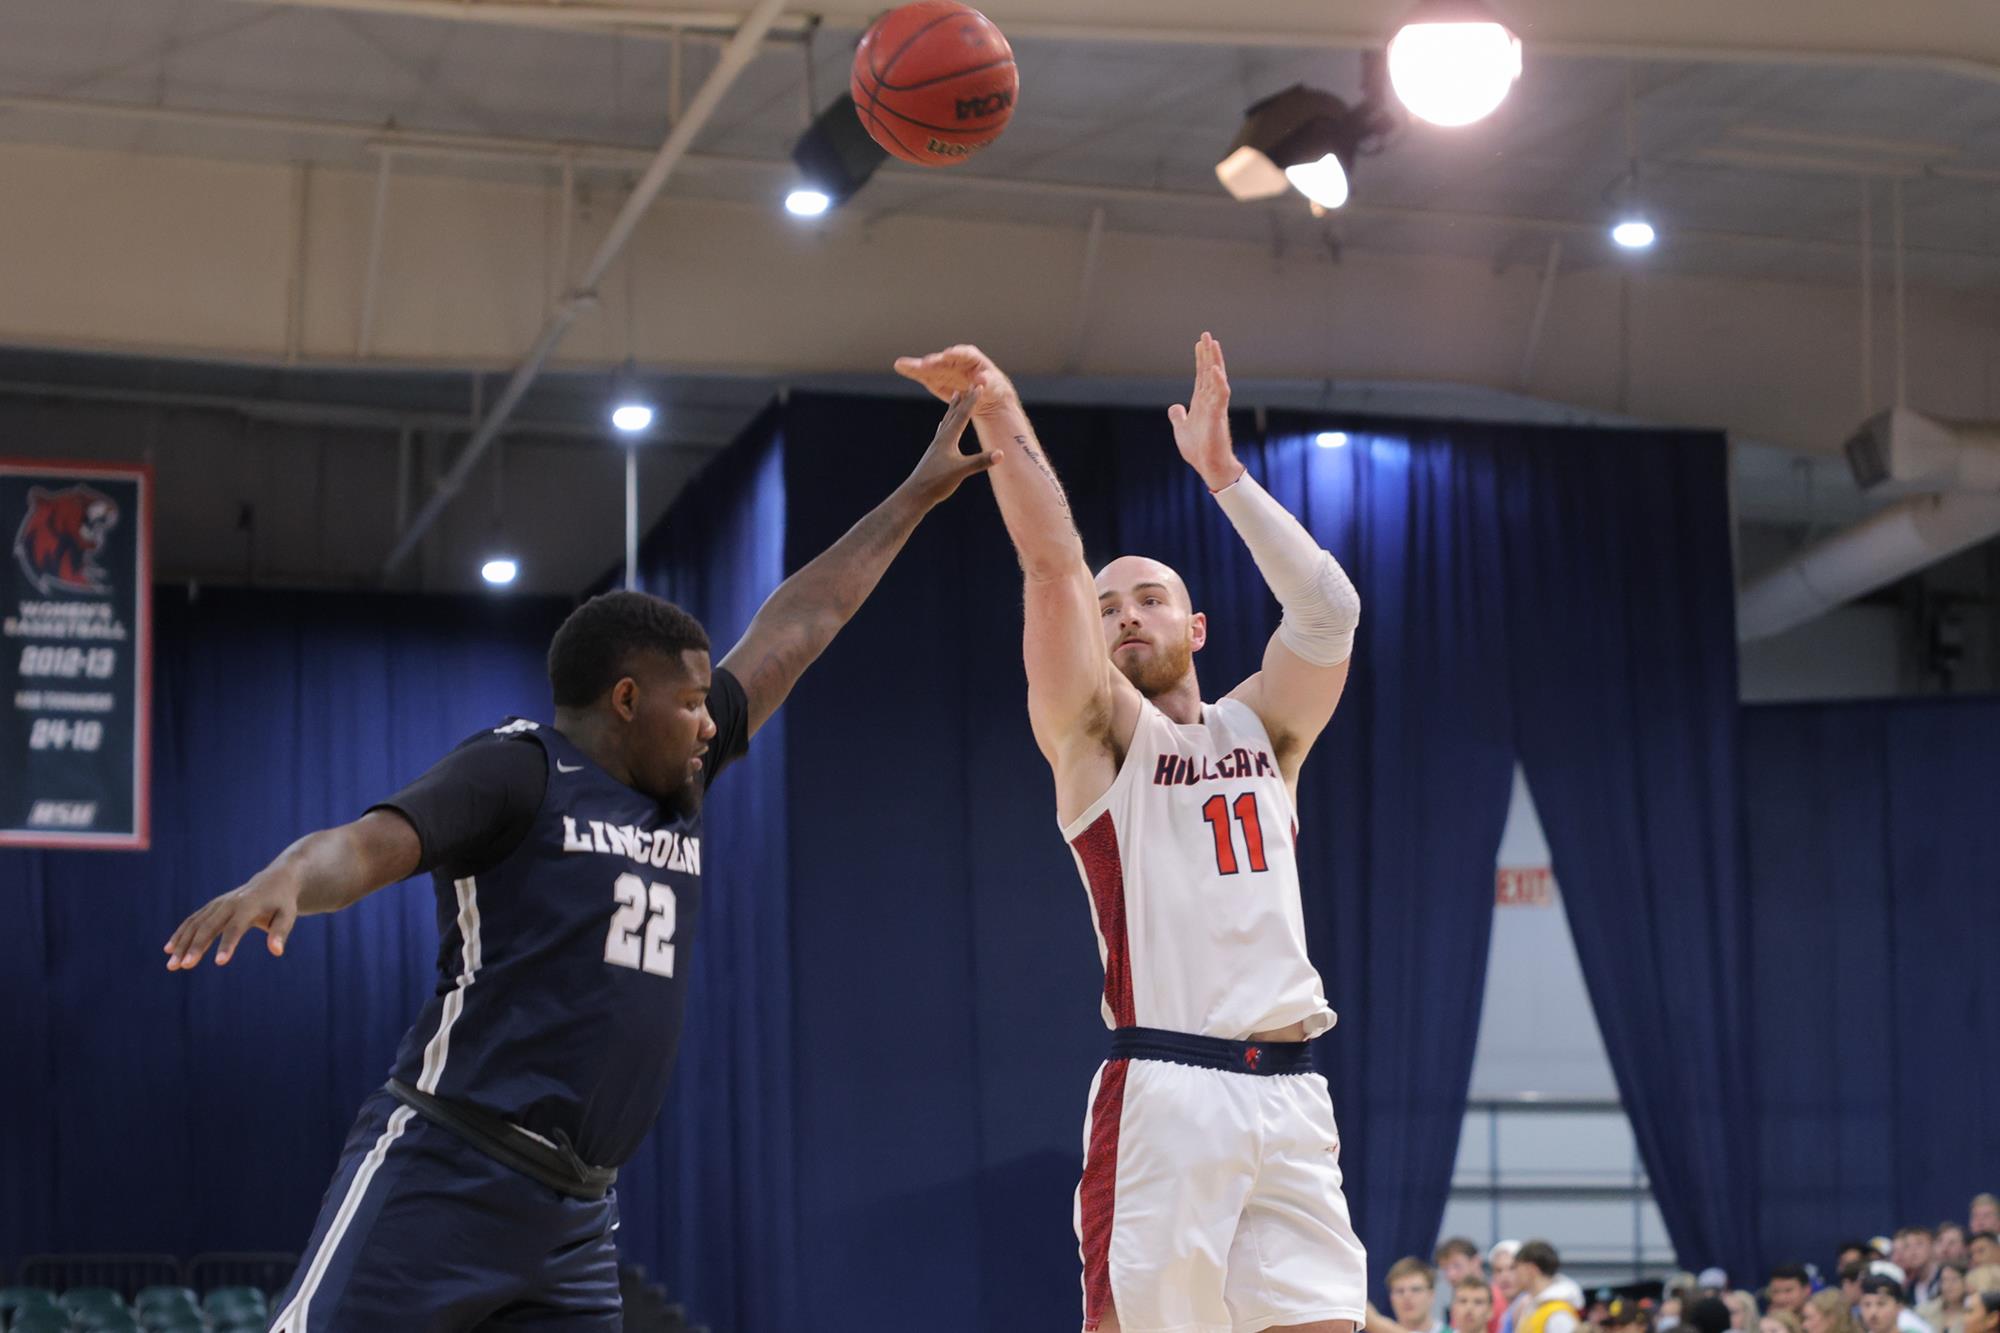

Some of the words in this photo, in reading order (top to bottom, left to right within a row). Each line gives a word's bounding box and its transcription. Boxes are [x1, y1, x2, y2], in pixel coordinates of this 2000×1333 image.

[19, 646, 115, 678] 2012-13
[563, 815, 700, 876] LINCOLN
[1202, 791, 1269, 876] 11
[1496, 867, 1553, 905] EXIT
[603, 871, 676, 979] 22
